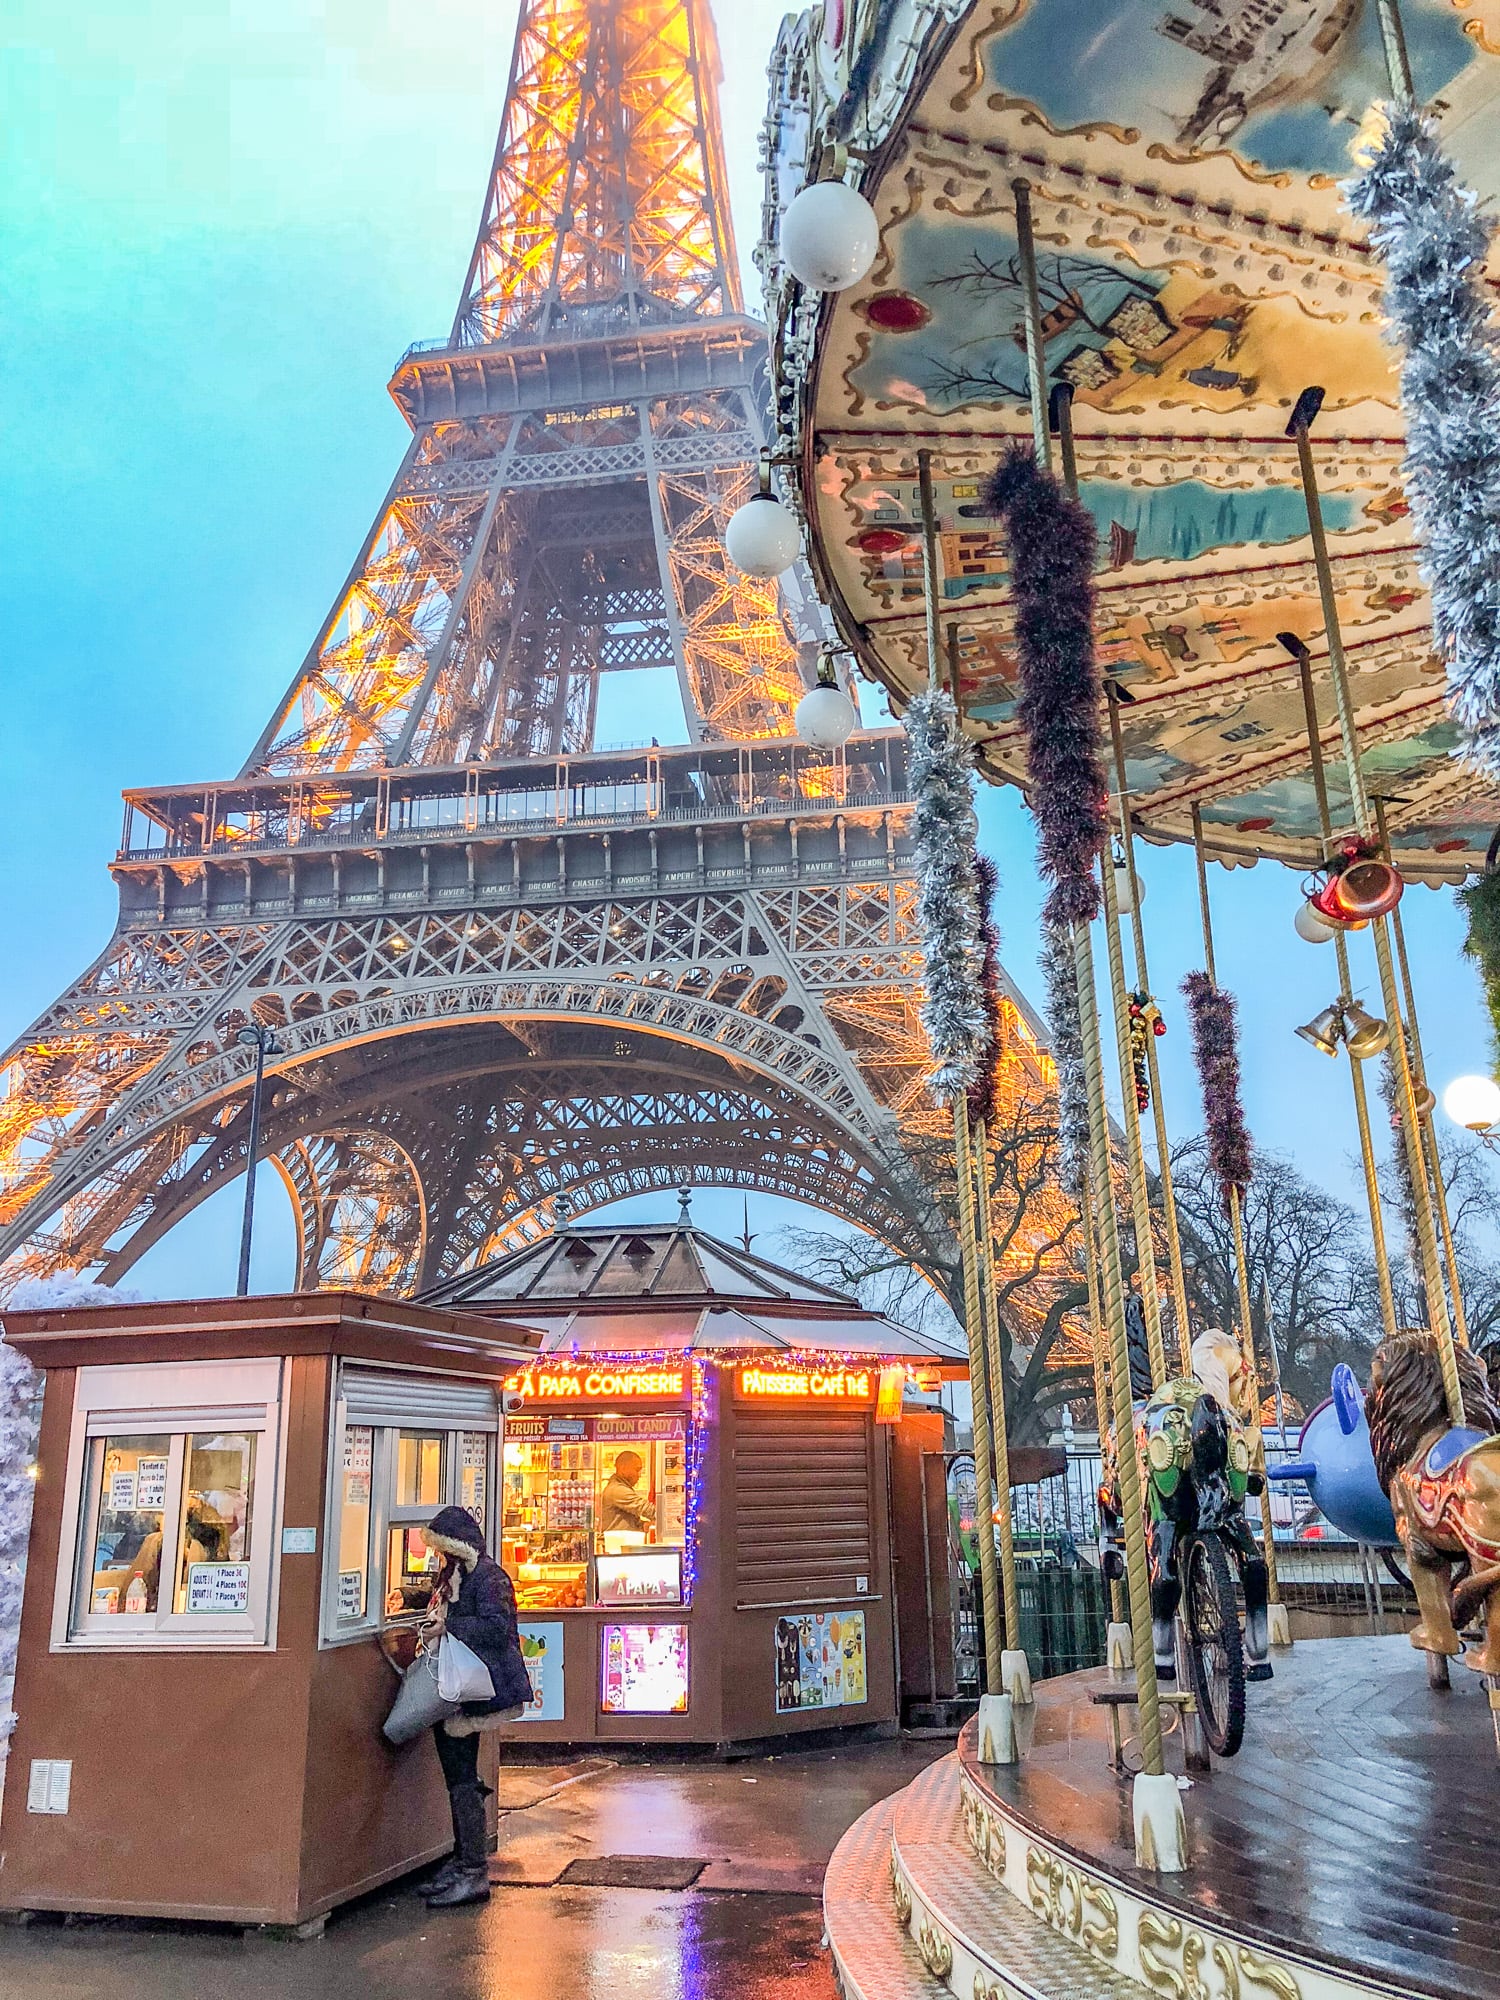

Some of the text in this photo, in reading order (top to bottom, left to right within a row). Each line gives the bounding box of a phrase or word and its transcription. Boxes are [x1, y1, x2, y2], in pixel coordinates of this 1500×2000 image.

[805, 862, 833, 872] NAVIER
[851, 858, 886, 868] LEGENDRE
[706, 868, 744, 878] CHEVREUL
[757, 865, 788, 875] FLACHAT
[617, 875, 651, 885] LAVOISIER
[665, 871, 695, 881] AMPERE
[528, 881, 557, 891] DULONG
[572, 878, 604, 888] CHASLES
[438, 887, 465, 896] CUVIER
[482, 884, 511, 894] LAPLACE
[303, 897, 332, 906] BRESSE
[520, 1374, 534, 1396] À
[539, 1376, 581, 1396] PAPA
[585, 1374, 683, 1395] CONFISERIE
[743, 1370, 869, 1397] PÂTISSERIE CAFÉ THÉ
[510, 1422, 545, 1435] FRUITS
[597, 1421, 635, 1433] COTTON
[637, 1420, 672, 1432] CANDY
[147, 1496, 154, 1504] 3
[221, 1569, 235, 1577] Place
[193, 1575, 207, 1584] ADULTE
[215, 1580, 247, 1589] 4 Places 10€
[626, 1581, 661, 1596] PAPA
[192, 1589, 206, 1599] ENFANT
[219, 1592, 236, 1600] Places
[237, 1592, 246, 1600] 15€
